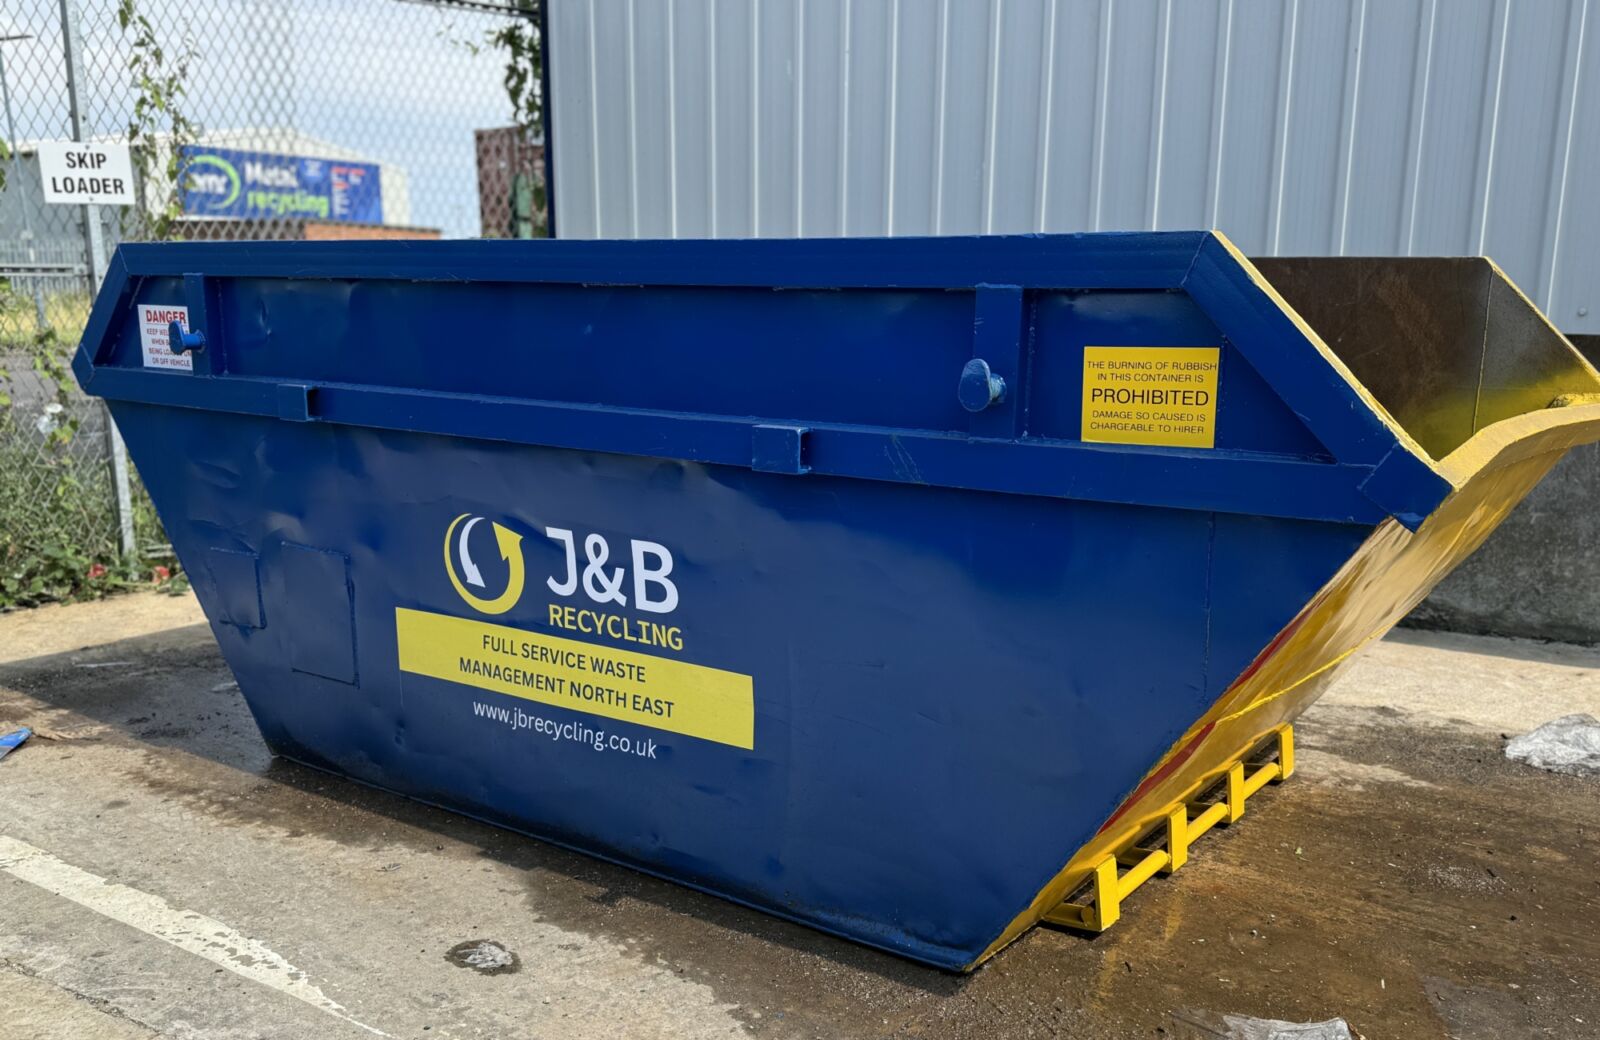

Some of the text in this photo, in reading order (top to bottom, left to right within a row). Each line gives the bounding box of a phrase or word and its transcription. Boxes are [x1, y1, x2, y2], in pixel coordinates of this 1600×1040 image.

[65, 151, 107, 169] SKIP
[52, 176, 125, 194] LOADER
[247, 189, 329, 218] recycling
[145, 310, 187, 324] DANGER
[169, 358, 190, 367] VEHICLE
[1087, 361, 1217, 371] THE BURNING OF RUBBISH
[1097, 373, 1204, 383] IN THIS CONTAINER IS
[1091, 388, 1209, 406] PROHIBITED
[1092, 410, 1206, 422] DAMAGE SO CAUSED IS
[1090, 421, 1204, 434] CHARGEABLE TO HIRER
[545, 526, 679, 614] J&B
[548, 604, 684, 651] RECYCLING
[482, 634, 647, 683] FULL SERVICE WASTE
[459, 656, 675, 718] MANAGEMENT NORTH EAST
[472, 701, 657, 760] www.jbrecycling.co.uk
